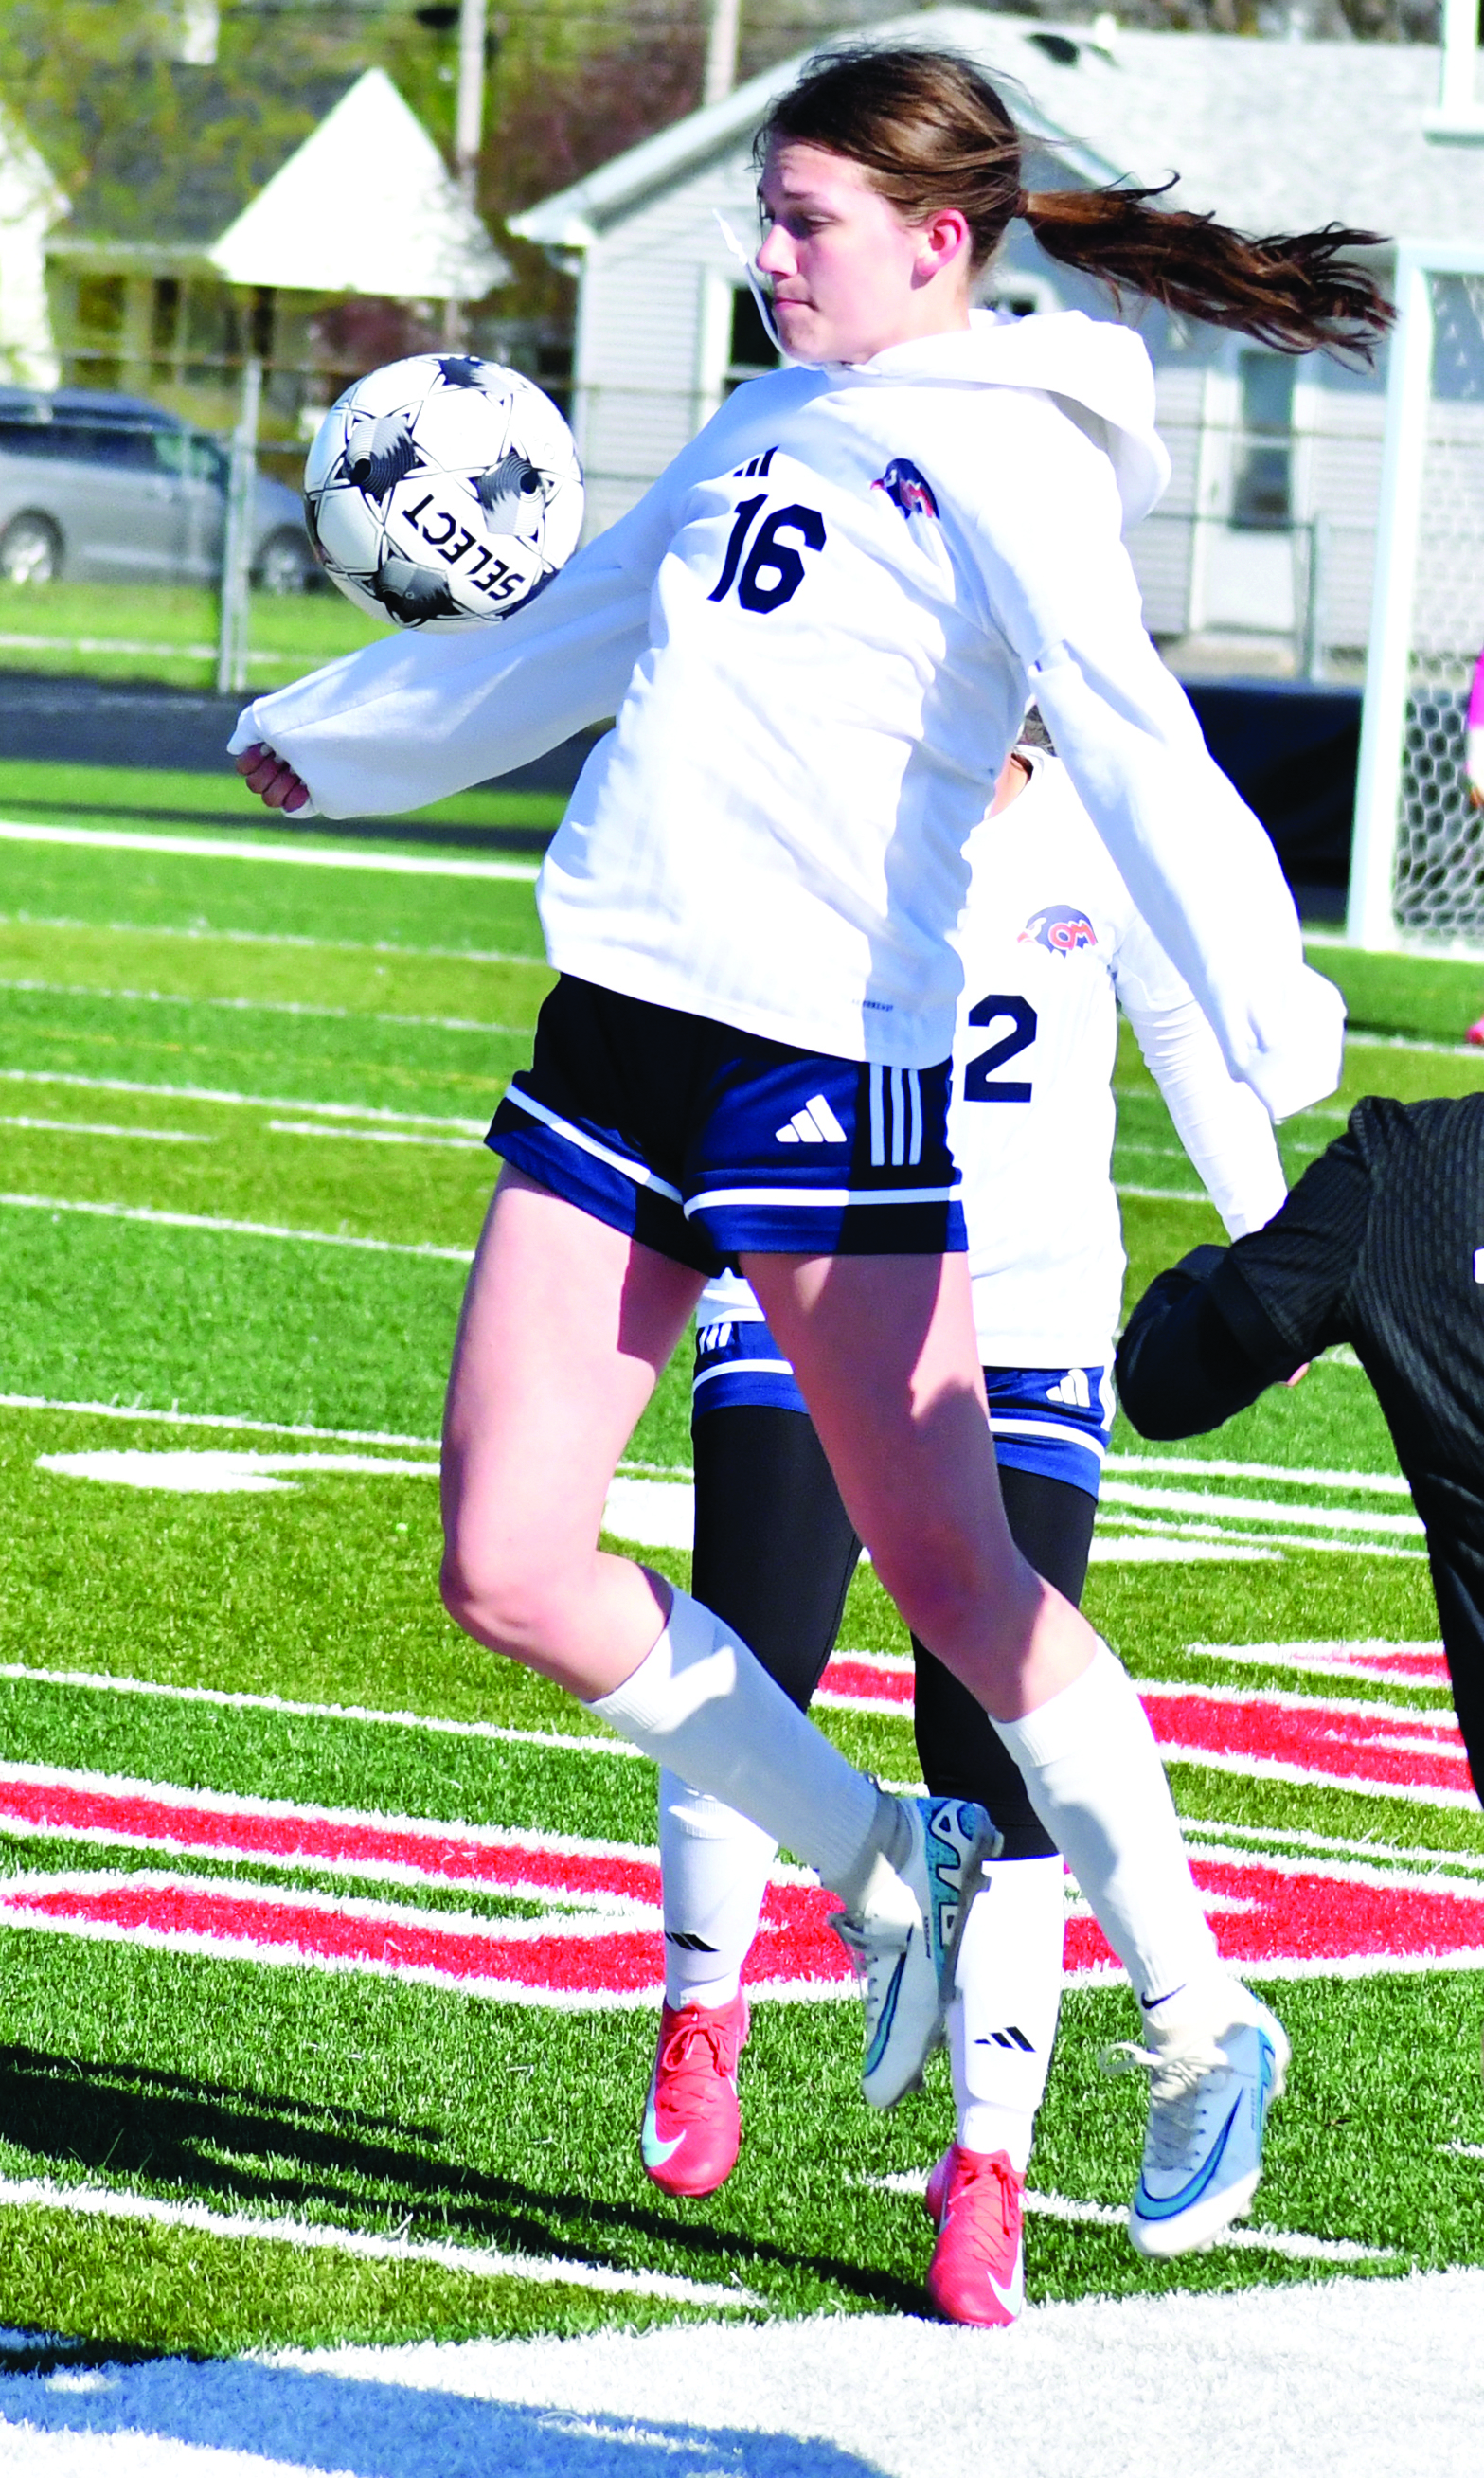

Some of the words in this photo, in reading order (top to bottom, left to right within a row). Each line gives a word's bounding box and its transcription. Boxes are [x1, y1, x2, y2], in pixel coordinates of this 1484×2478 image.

[402, 494, 526, 601] SELECT
[706, 494, 827, 615] 16
[1047, 919, 1098, 951] OM
[963, 994, 1038, 1103] 2
